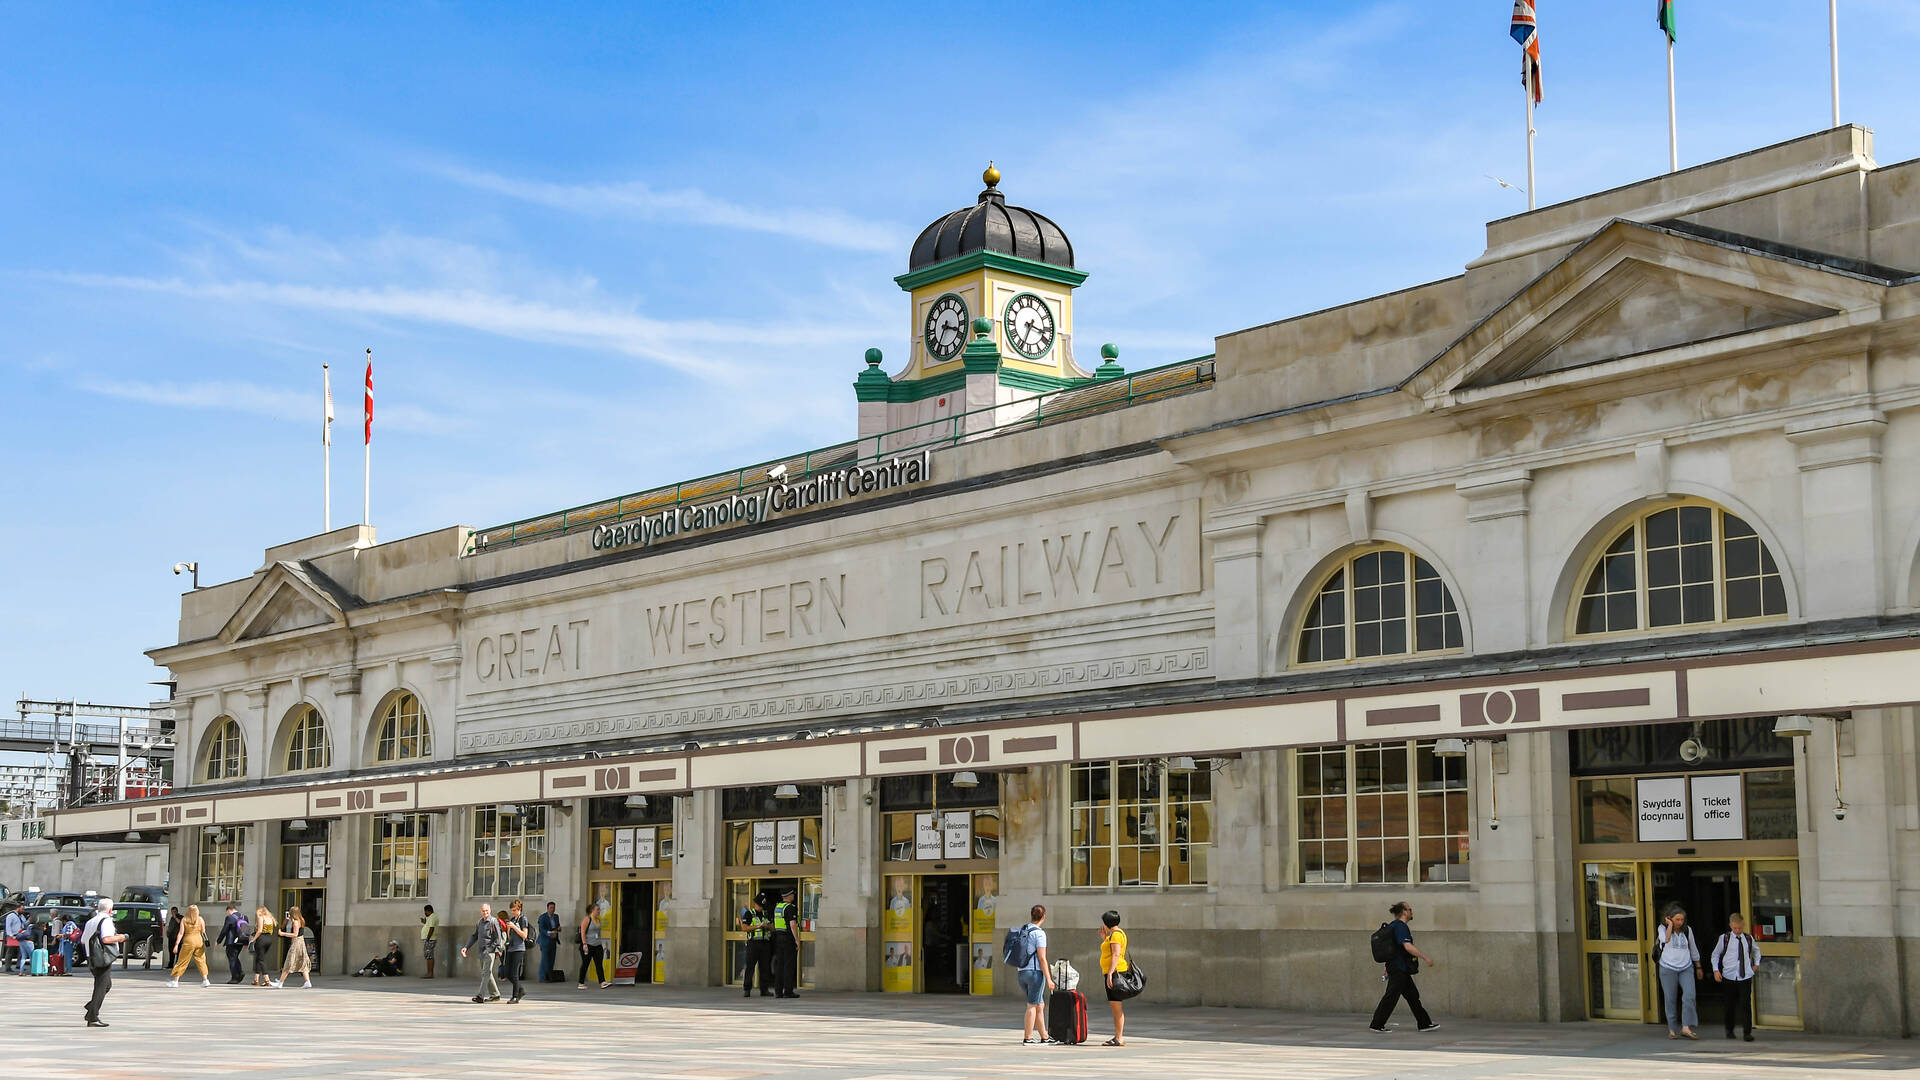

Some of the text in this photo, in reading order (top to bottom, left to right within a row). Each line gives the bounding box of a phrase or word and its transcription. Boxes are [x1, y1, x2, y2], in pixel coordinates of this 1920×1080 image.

[592, 508, 680, 550] Caerdydd
[846, 450, 930, 496] Central
[646, 574, 846, 657] WESTERN
[920, 514, 1181, 619] RAILWAY
[1642, 798, 1682, 810] Swyddfa
[1702, 796, 1731, 807] Ticket
[1640, 812, 1684, 822] docynnau
[1703, 809, 1730, 819] office
[949, 840, 966, 848] Cardiff
